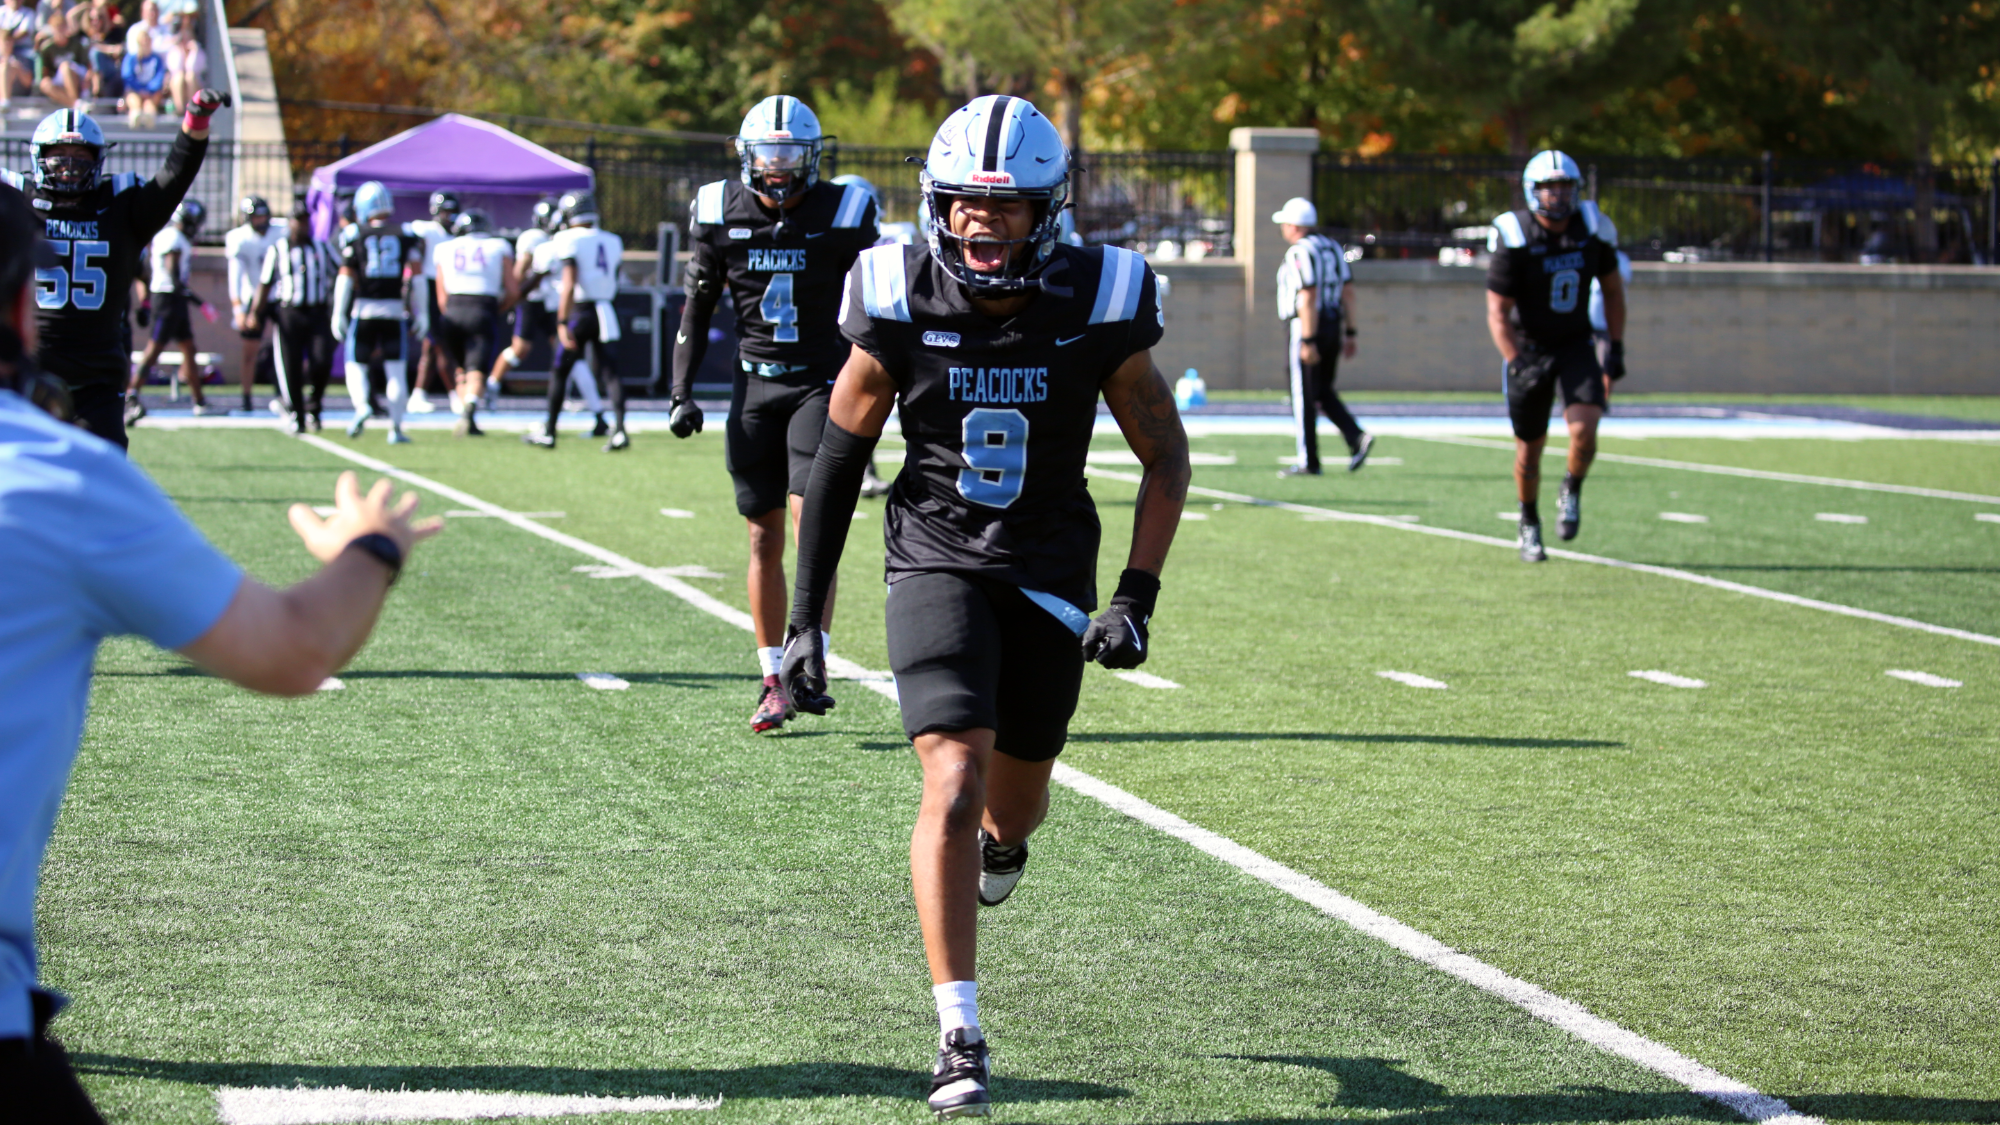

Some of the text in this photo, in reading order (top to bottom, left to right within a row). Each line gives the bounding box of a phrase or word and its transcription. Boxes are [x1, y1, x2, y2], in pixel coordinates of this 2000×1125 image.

[972, 174, 1010, 184] Riddell
[45, 218, 99, 239] PEACOCKS
[34, 239, 110, 310] 55
[364, 234, 401, 278] 12
[747, 249, 807, 272] PEACOCKS
[759, 273, 800, 342] 4
[1550, 268, 1581, 314] 0
[948, 366, 1049, 404] PEACOCKS
[955, 407, 1030, 510] 9
